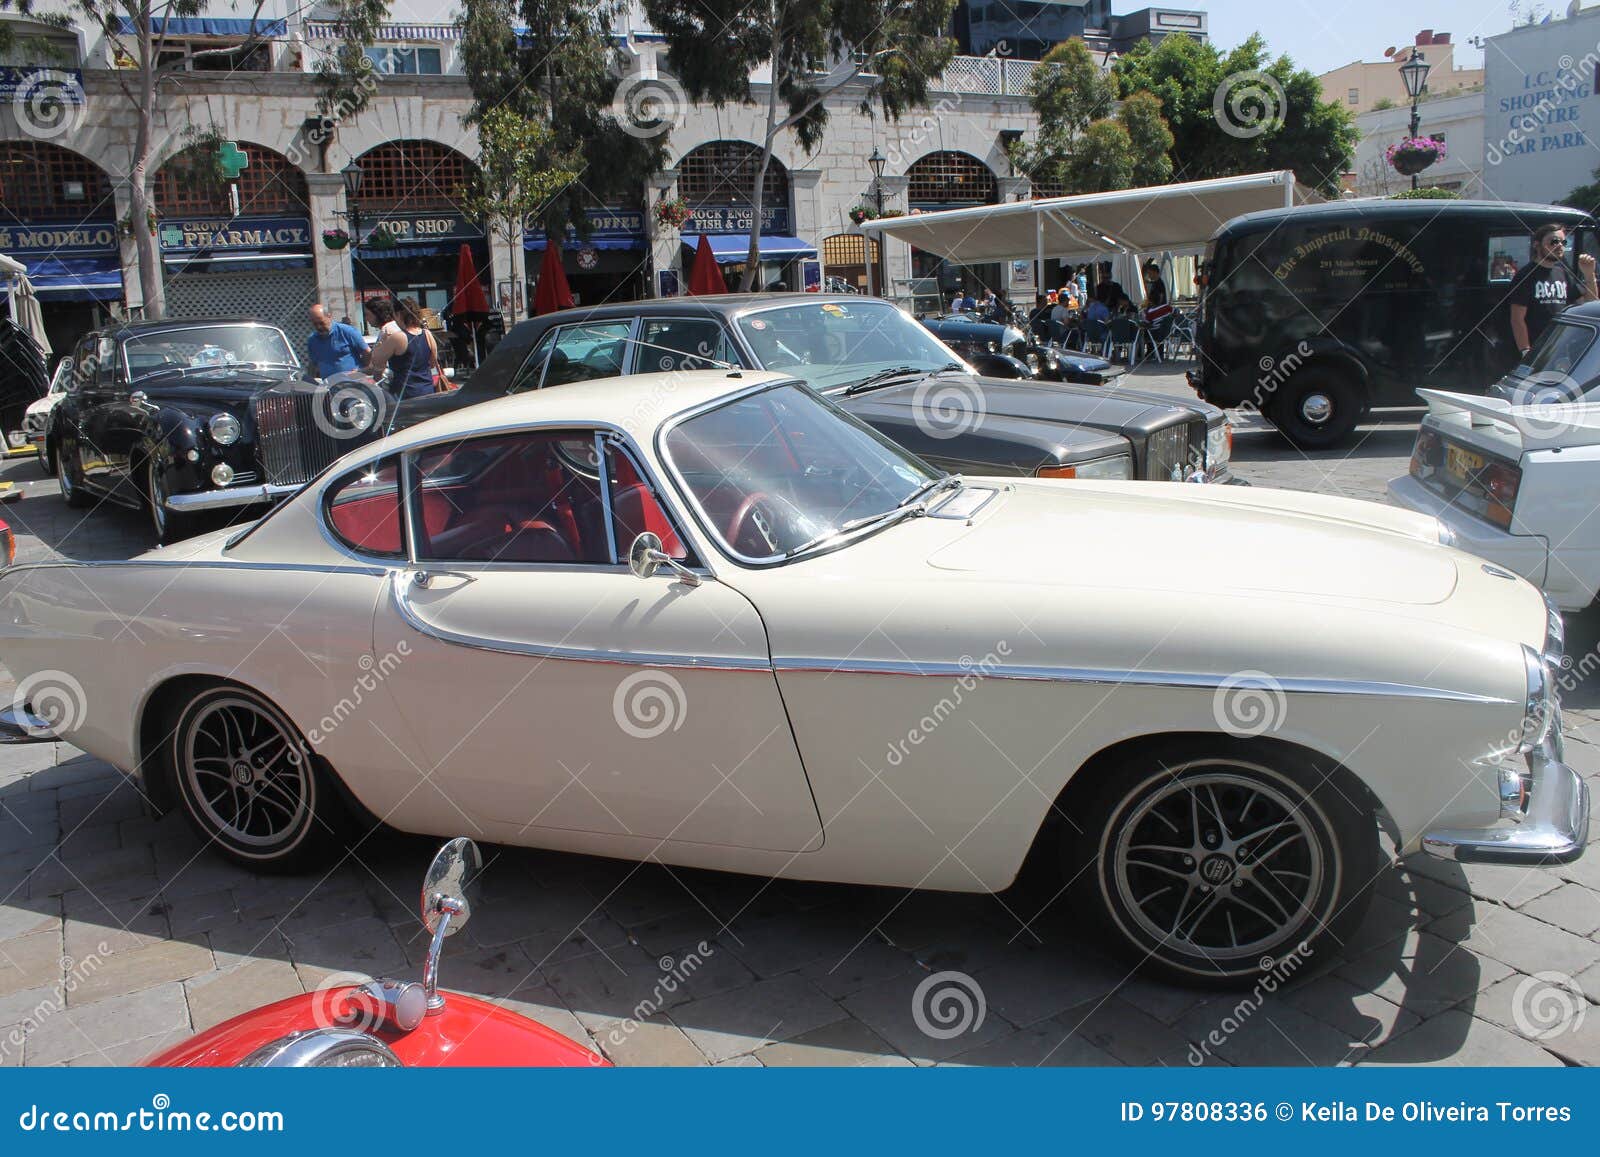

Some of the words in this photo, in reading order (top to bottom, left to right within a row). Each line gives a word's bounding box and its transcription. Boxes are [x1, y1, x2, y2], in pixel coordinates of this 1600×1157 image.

[1541, 131, 1586, 151] PARK
[183, 222, 230, 232] CROWN
[378, 220, 410, 235] TOP
[416, 219, 457, 234] SHOP
[695, 219, 722, 229] FISH
[725, 219, 734, 229] &
[17, 230, 112, 248] MODELO
[184, 229, 304, 247] PHARMACY
[1274, 257, 1297, 280] The
[1295, 227, 1351, 257] Imperial
